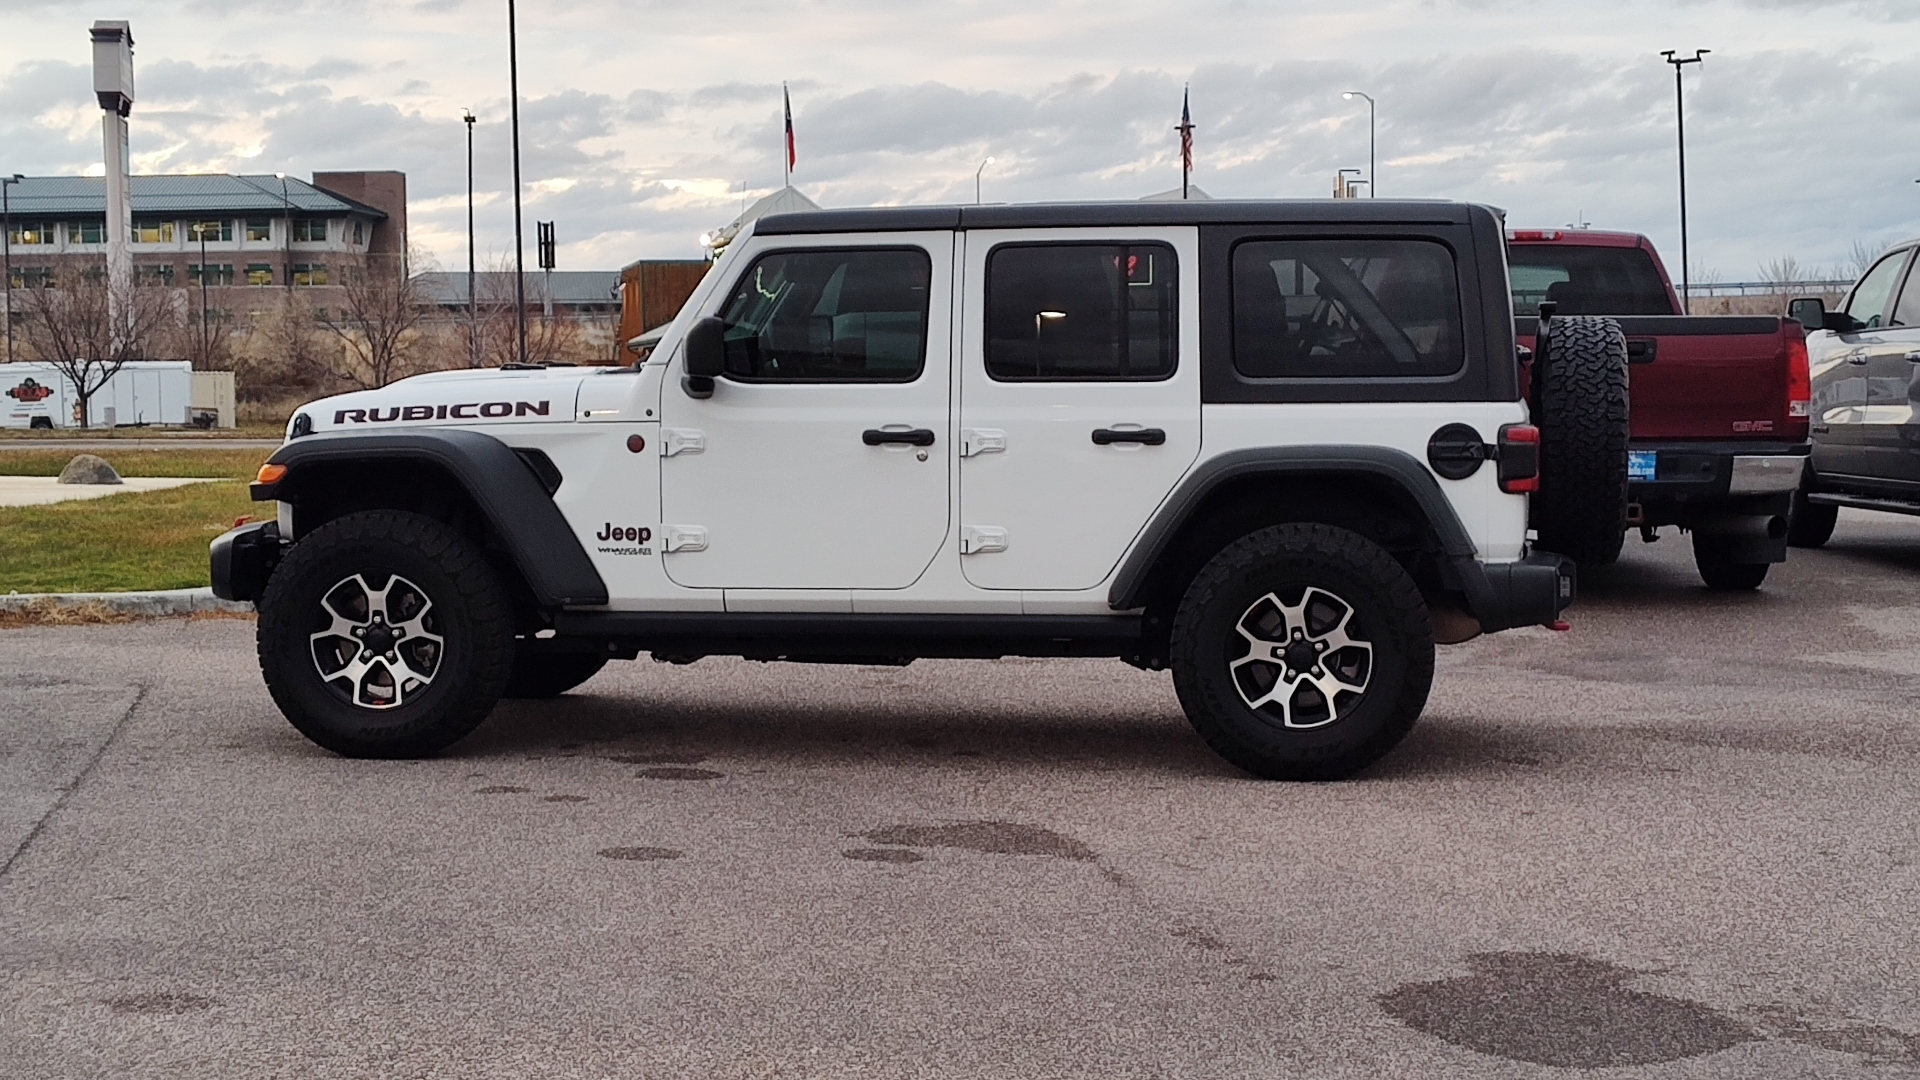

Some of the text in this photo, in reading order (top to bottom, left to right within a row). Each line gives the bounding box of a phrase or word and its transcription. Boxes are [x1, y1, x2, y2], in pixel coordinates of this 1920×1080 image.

[333, 400, 550, 425] RUBICON
[1733, 420, 1773, 432] GMC
[596, 522, 652, 545] Jeep
